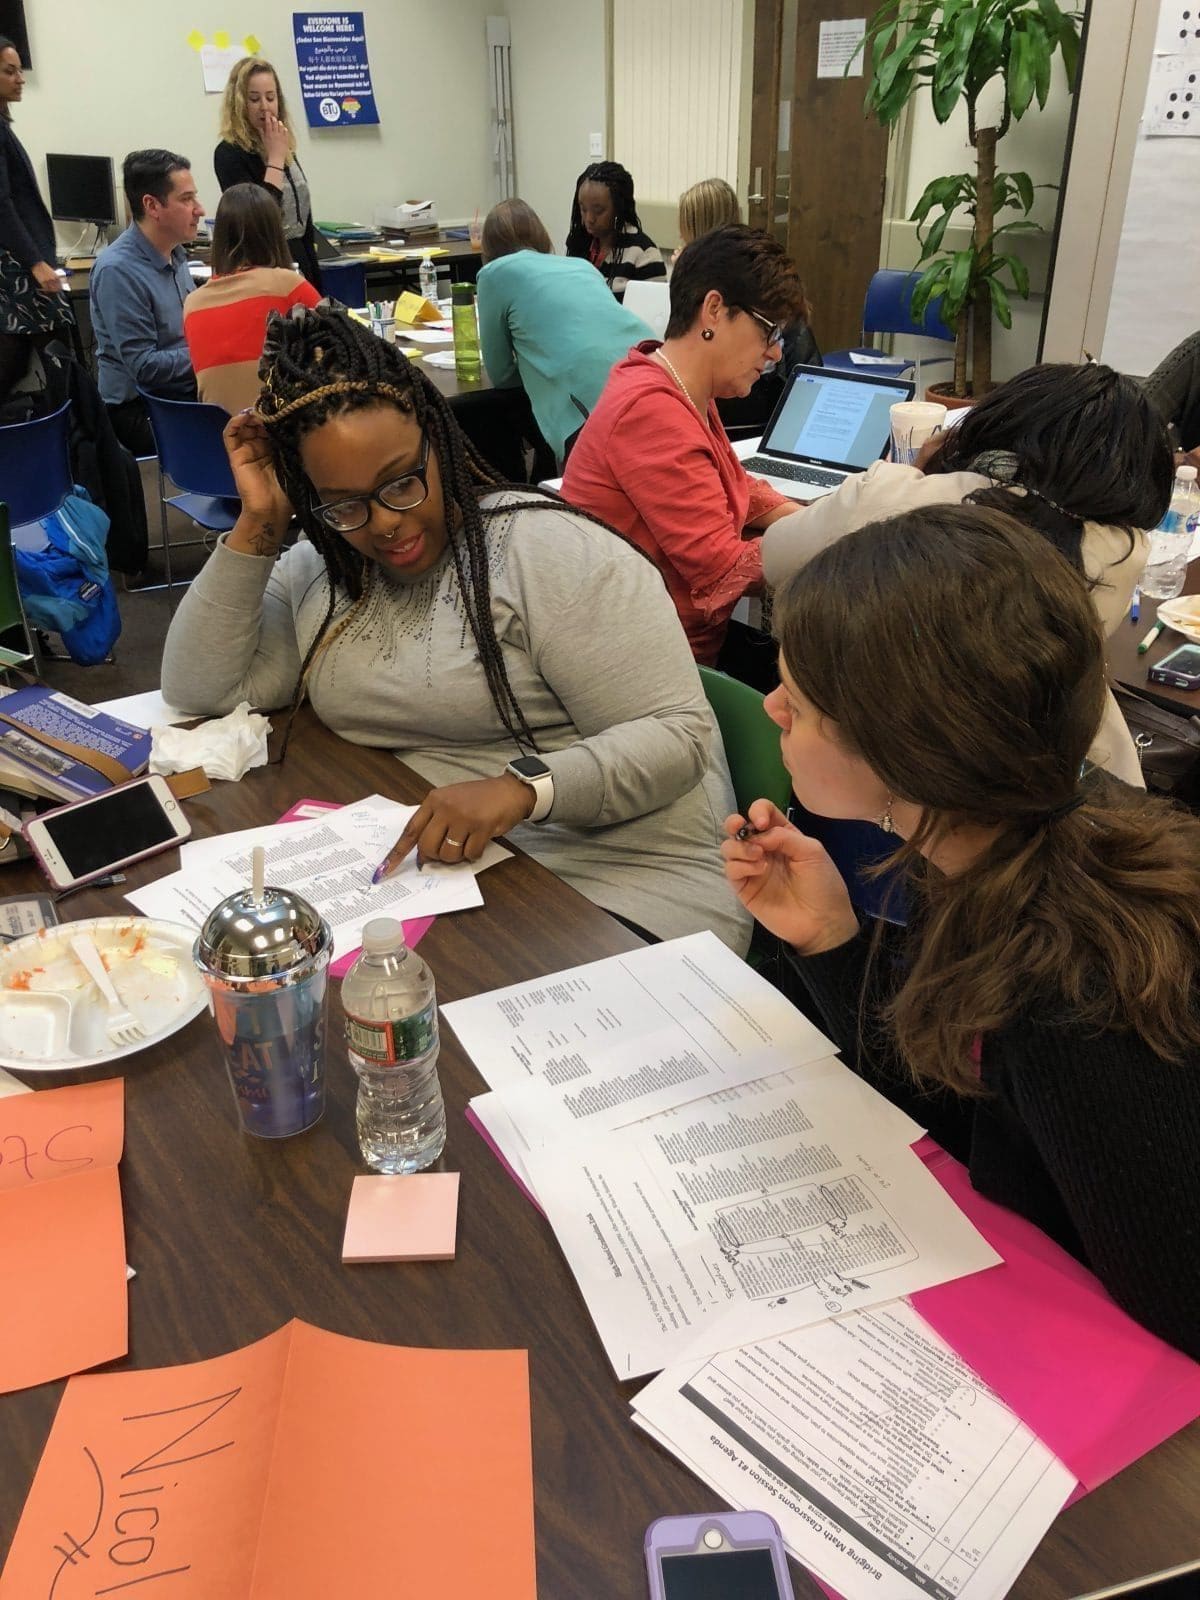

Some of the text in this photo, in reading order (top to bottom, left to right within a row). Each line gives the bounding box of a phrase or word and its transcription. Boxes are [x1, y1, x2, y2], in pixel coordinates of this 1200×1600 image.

[308, 17, 340, 25] EVERYONE
[336, 24, 354, 32] HERE!
[322, 102, 338, 114] BTU
[0, 1124, 93, 1179] St
[95, 1386, 242, 1595] Nicol
[786, 1487, 802, 1502] Time:
[873, 1484, 894, 1502] Course
[706, 1433, 883, 1580] Bridging Math Classrooms Session #1 Agenda
[893, 1499, 904, 1510] the
[826, 1519, 842, 1534] Date:
[909, 1510, 936, 1533] Overview
[885, 1550, 909, 1571] Activity
